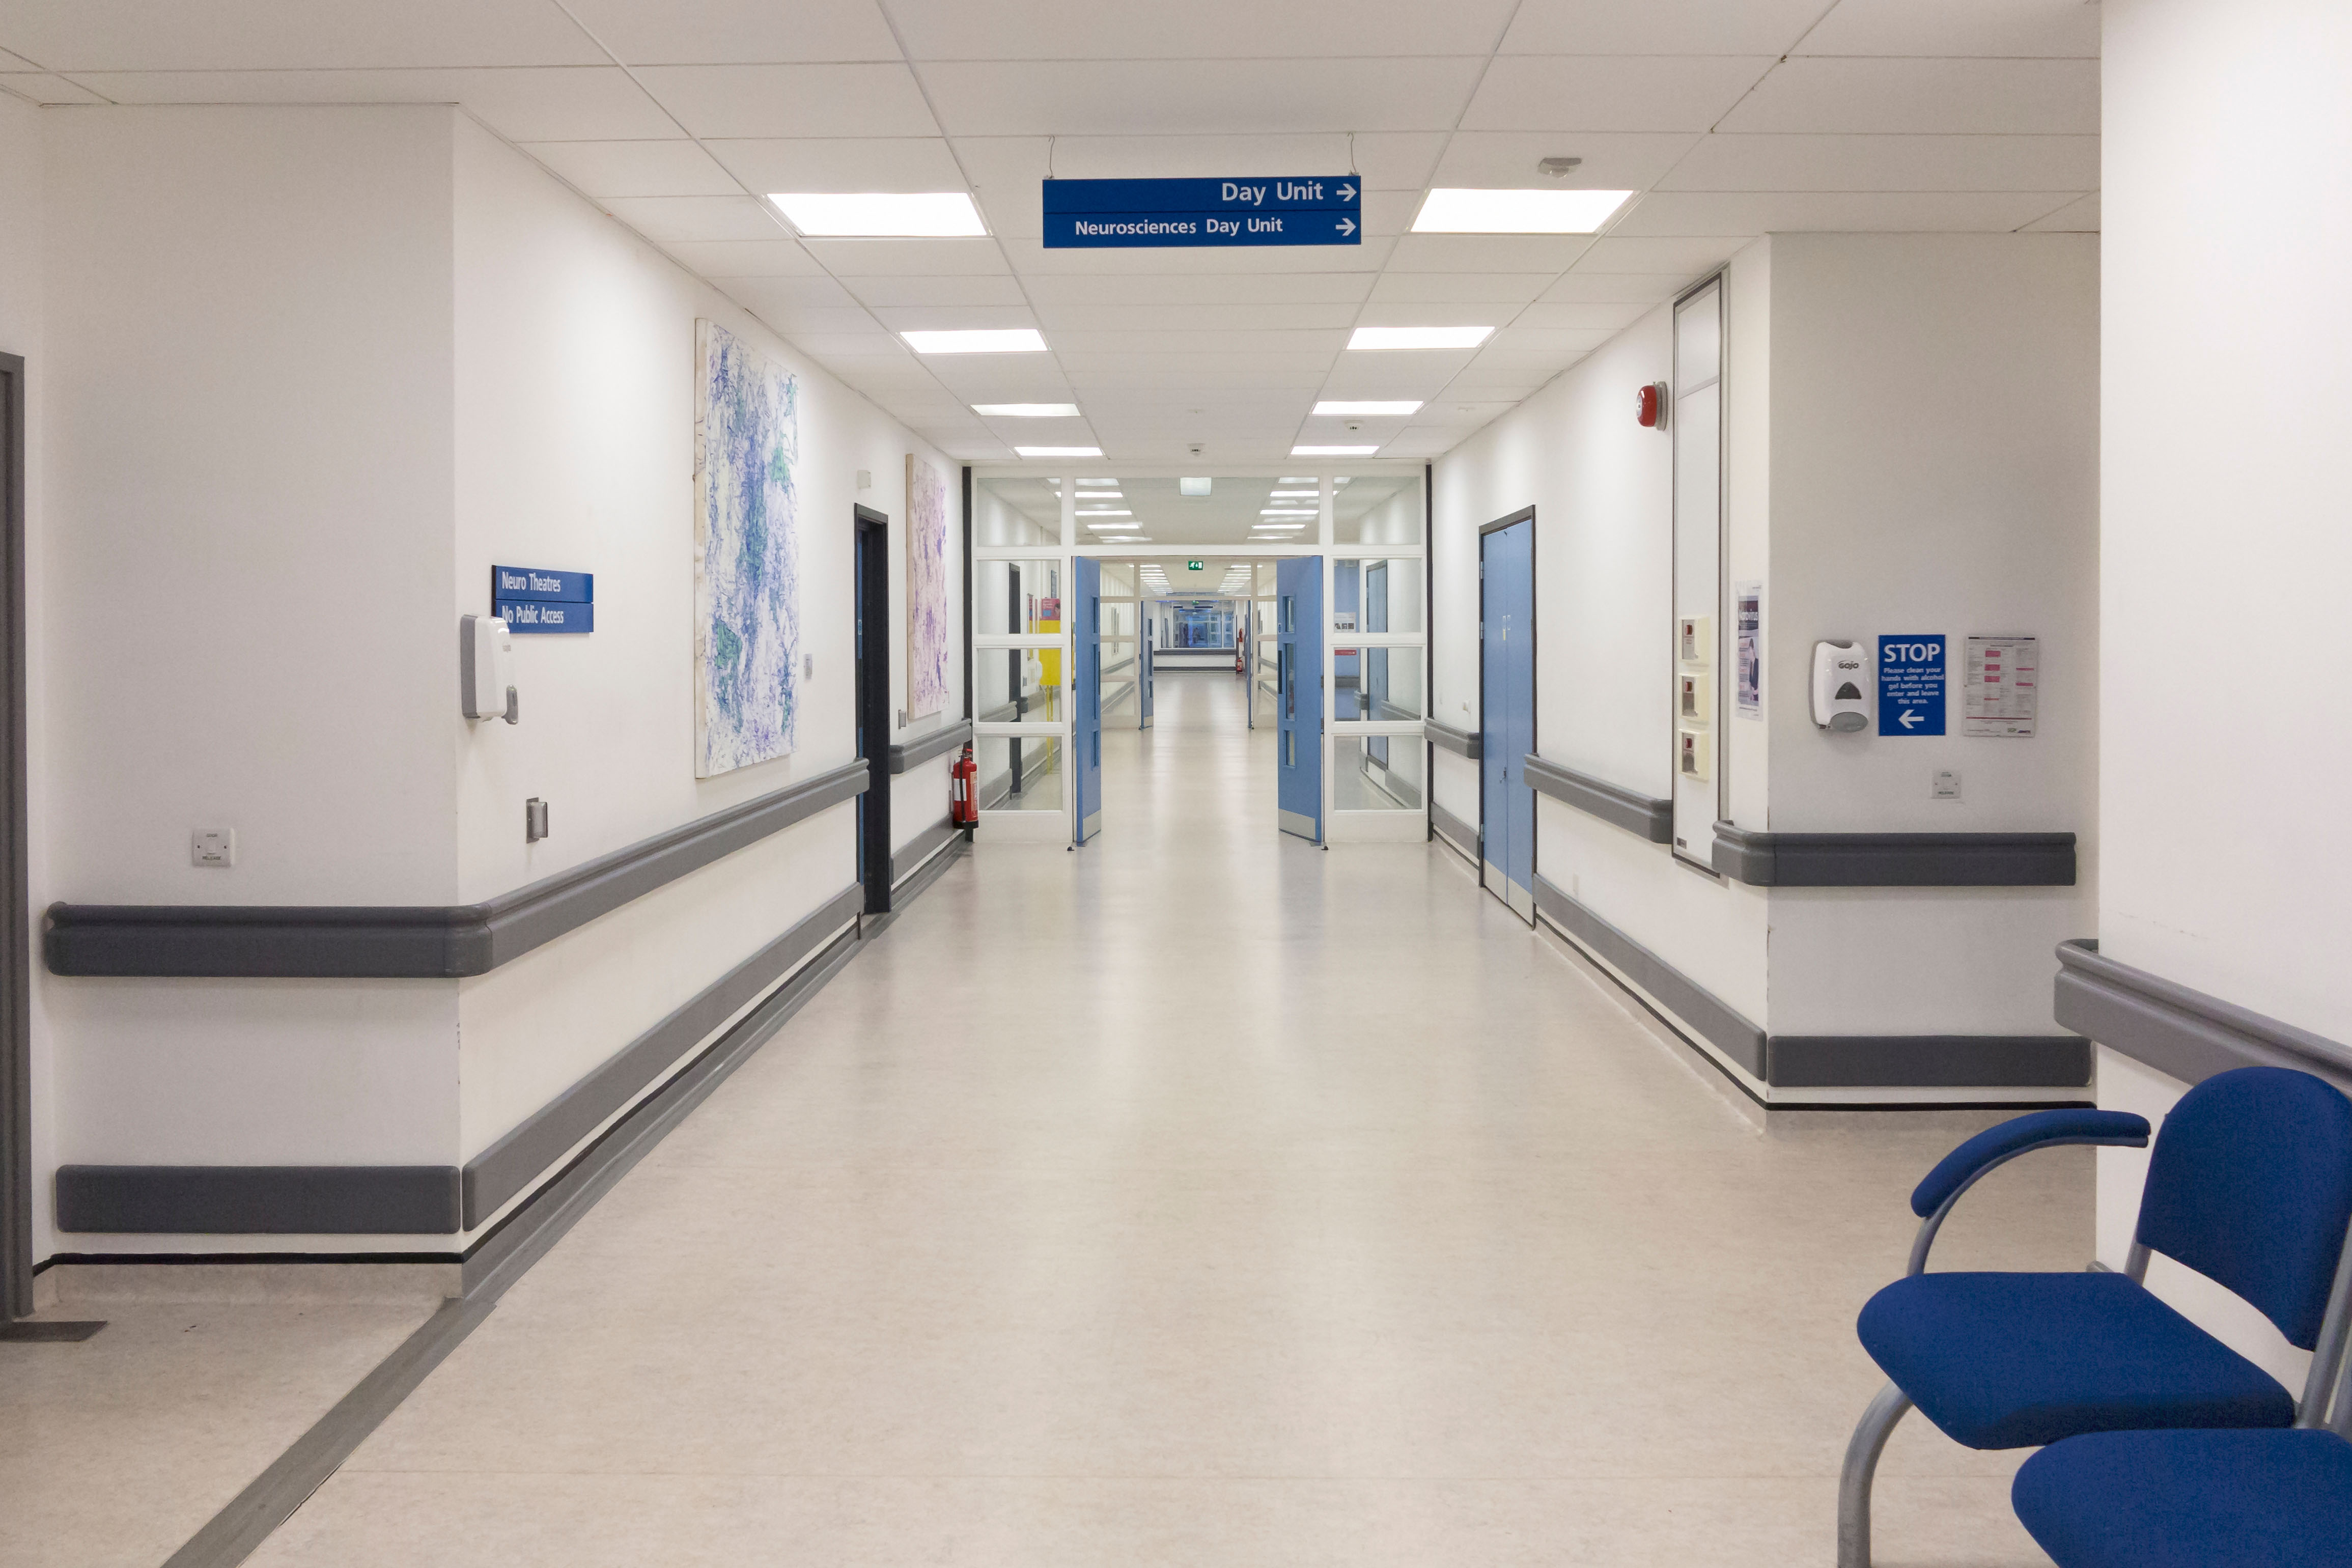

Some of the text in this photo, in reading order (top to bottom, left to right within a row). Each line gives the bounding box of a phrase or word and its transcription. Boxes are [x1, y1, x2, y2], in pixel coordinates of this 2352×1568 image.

[1222, 181, 1324, 206] Day Unit
[1076, 217, 1283, 236] Neurosciences Day Unit
[502, 571, 561, 592] Neuro Theatres
[501, 605, 564, 624] No Public Access
[1884, 643, 1941, 662] STOP
